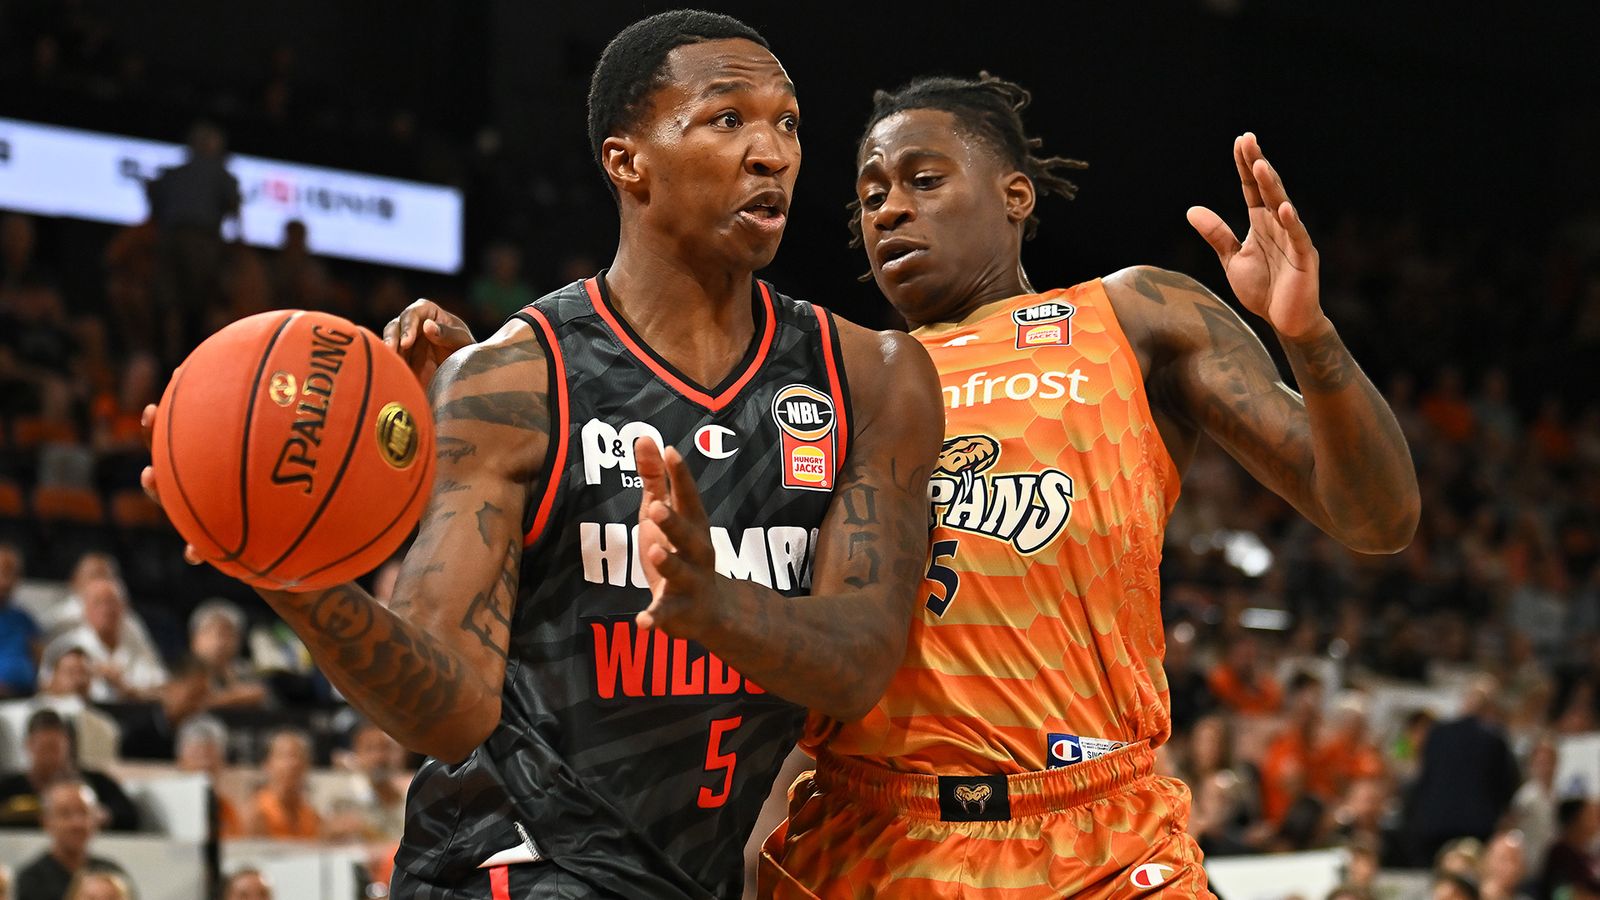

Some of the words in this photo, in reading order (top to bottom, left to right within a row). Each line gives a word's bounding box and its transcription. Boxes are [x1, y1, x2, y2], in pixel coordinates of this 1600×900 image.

[1026, 304, 1061, 320] NBL
[270, 325, 354, 494] SPALDING
[786, 402, 823, 425] NBL
[793, 456, 823, 464] HUNGRY
[794, 463, 823, 474] JACKS
[621, 473, 644, 488] ba
[697, 715, 742, 808] 5
